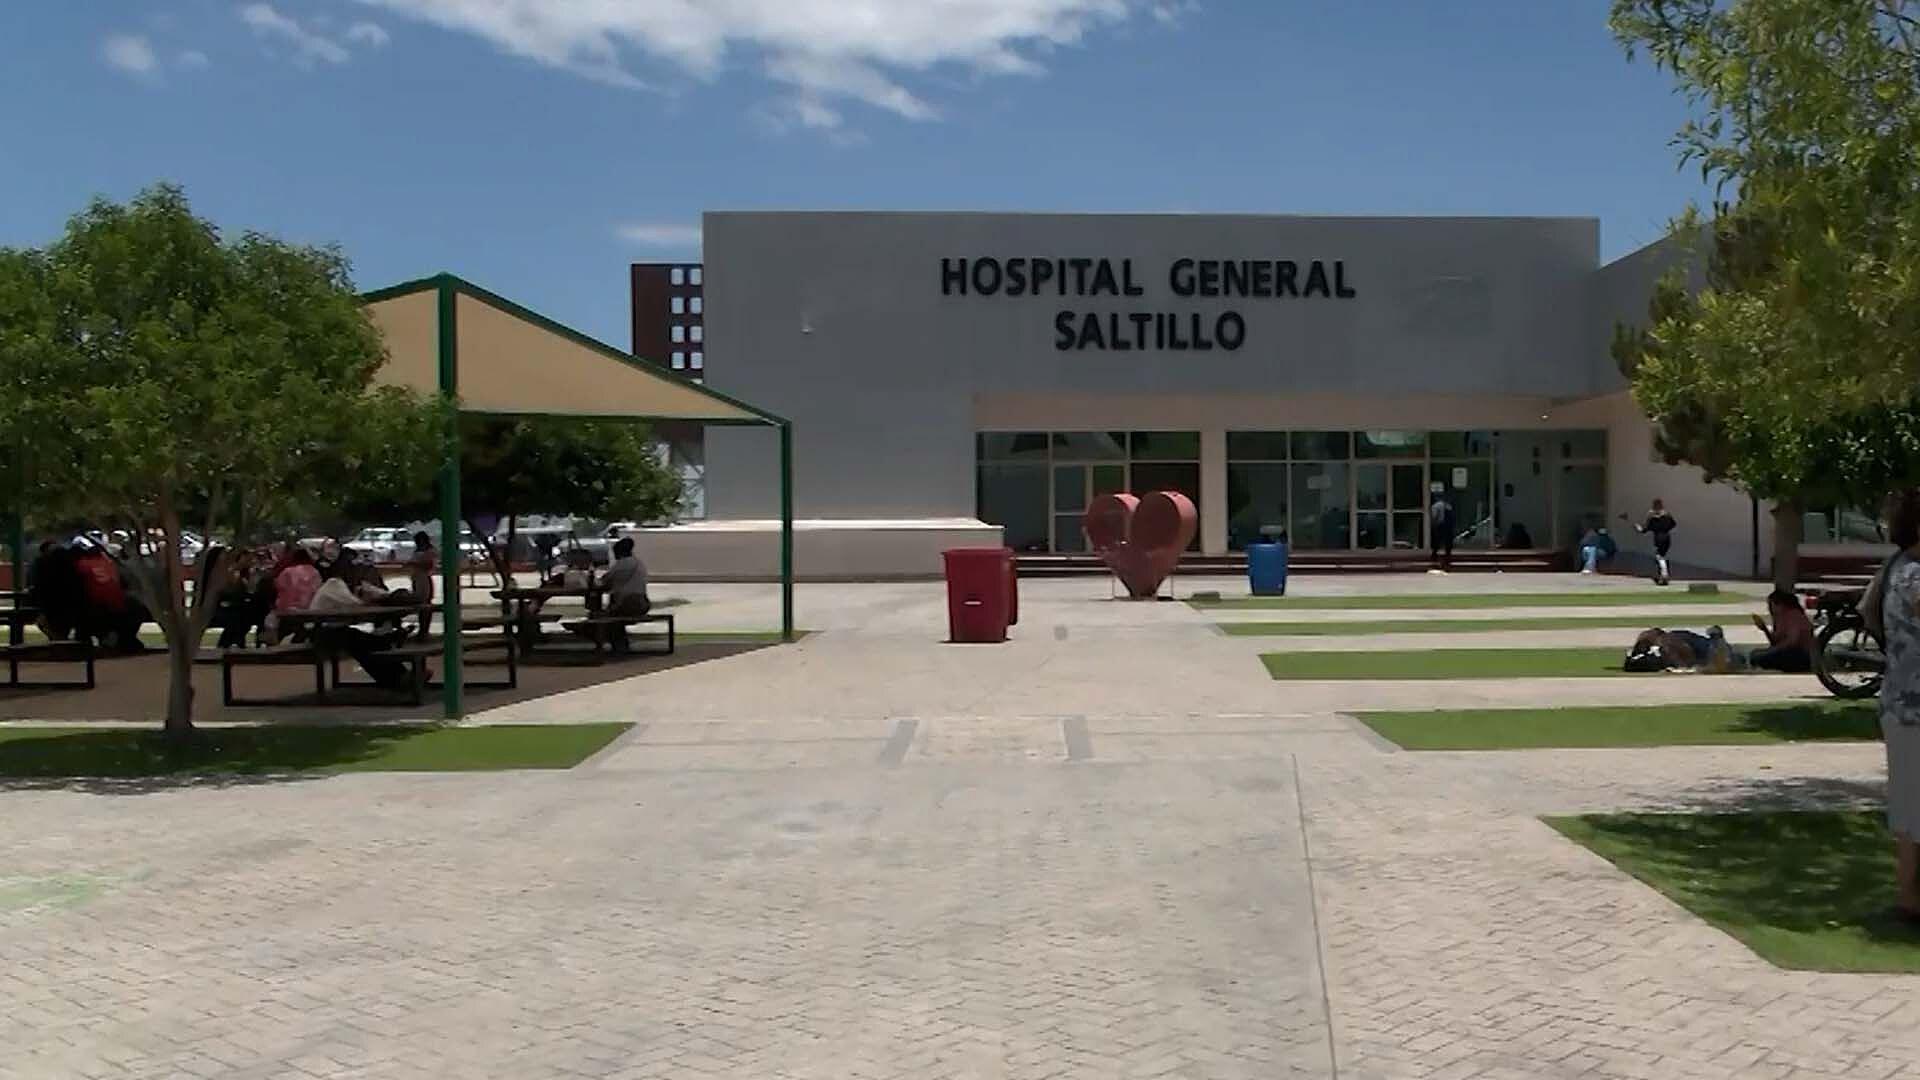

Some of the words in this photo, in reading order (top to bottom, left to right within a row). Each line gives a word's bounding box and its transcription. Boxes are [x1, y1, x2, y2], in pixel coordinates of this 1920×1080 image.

[941, 257, 1144, 296] HOSPITAL
[1168, 257, 1356, 298] GENERAL
[1054, 310, 1246, 351] SALTILLO
